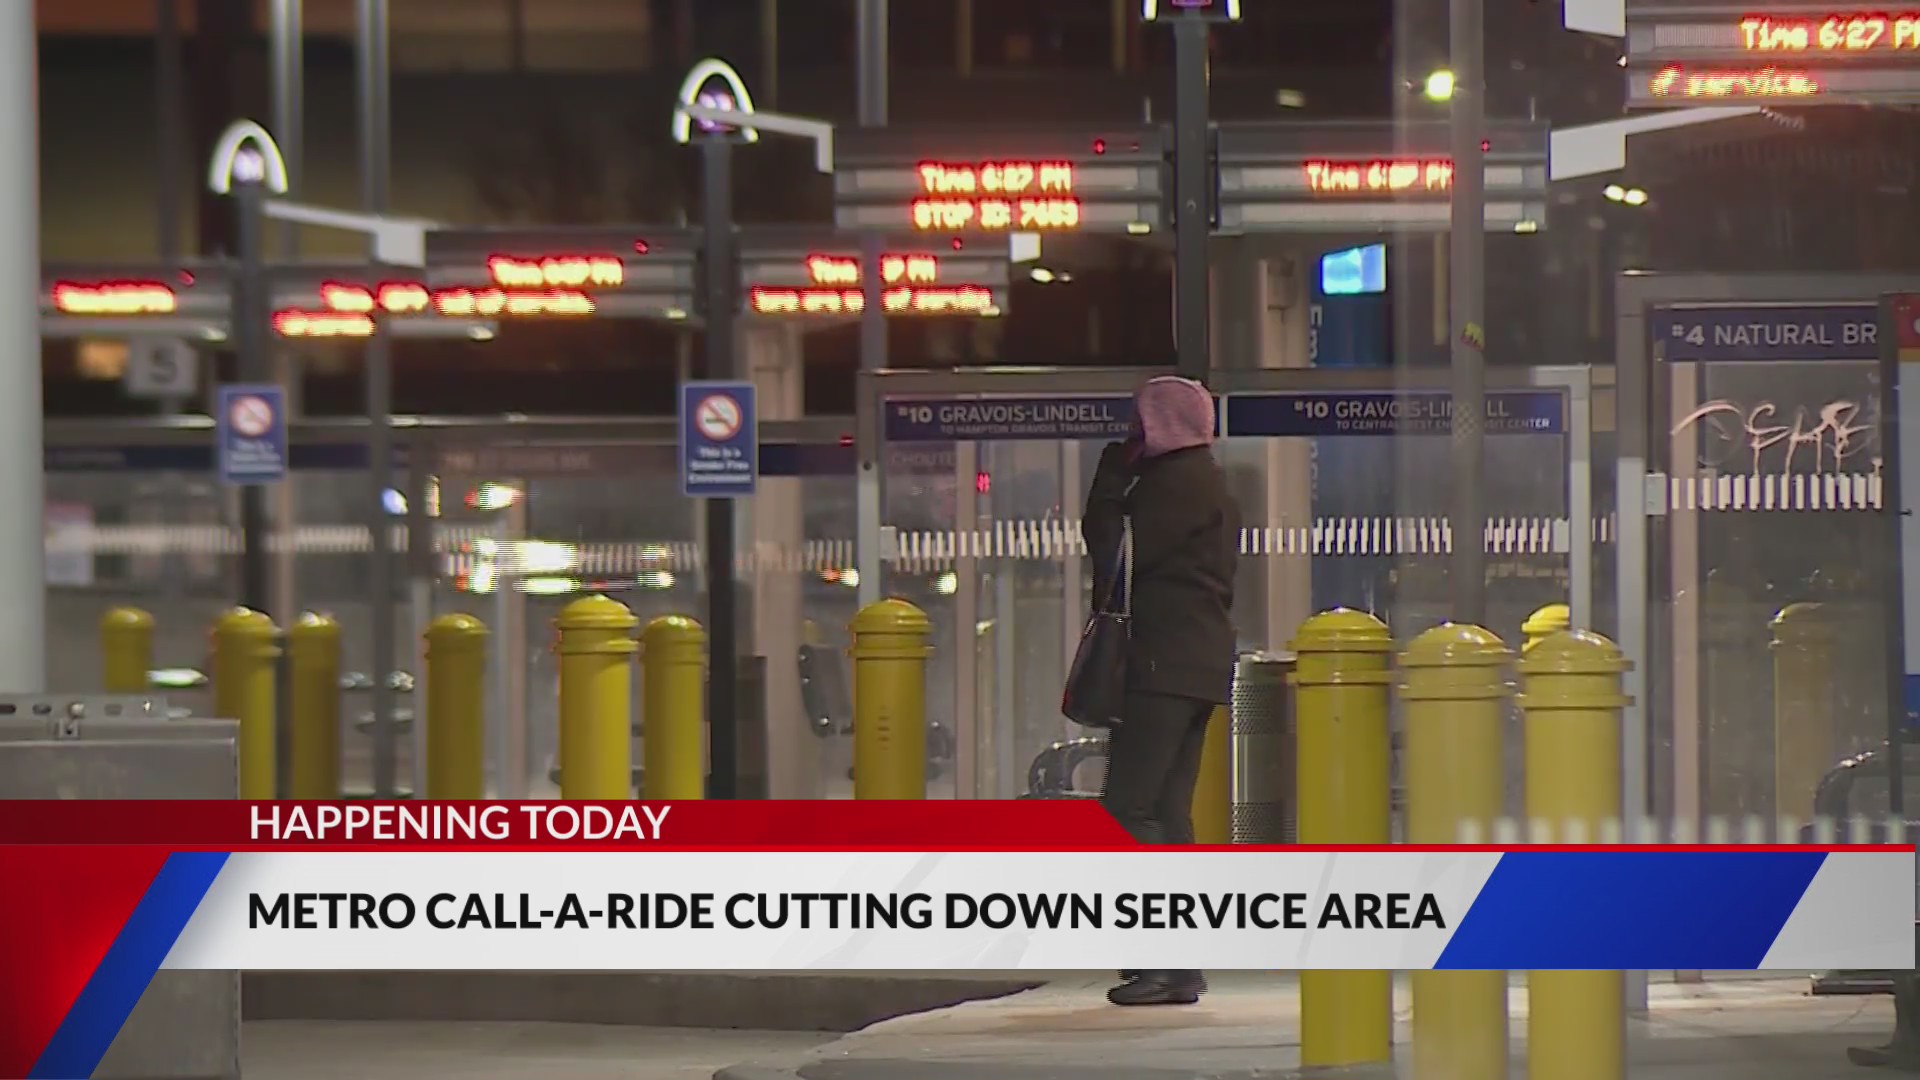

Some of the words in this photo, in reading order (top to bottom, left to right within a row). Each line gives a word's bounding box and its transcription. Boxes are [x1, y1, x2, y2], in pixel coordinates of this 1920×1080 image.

[1740, 18, 1809, 49] Time
[1818, 17, 1885, 49] 6:27
[1714, 323, 1835, 346] NATURAL
[939, 404, 1115, 423] GRAVOIS-LINDELL
